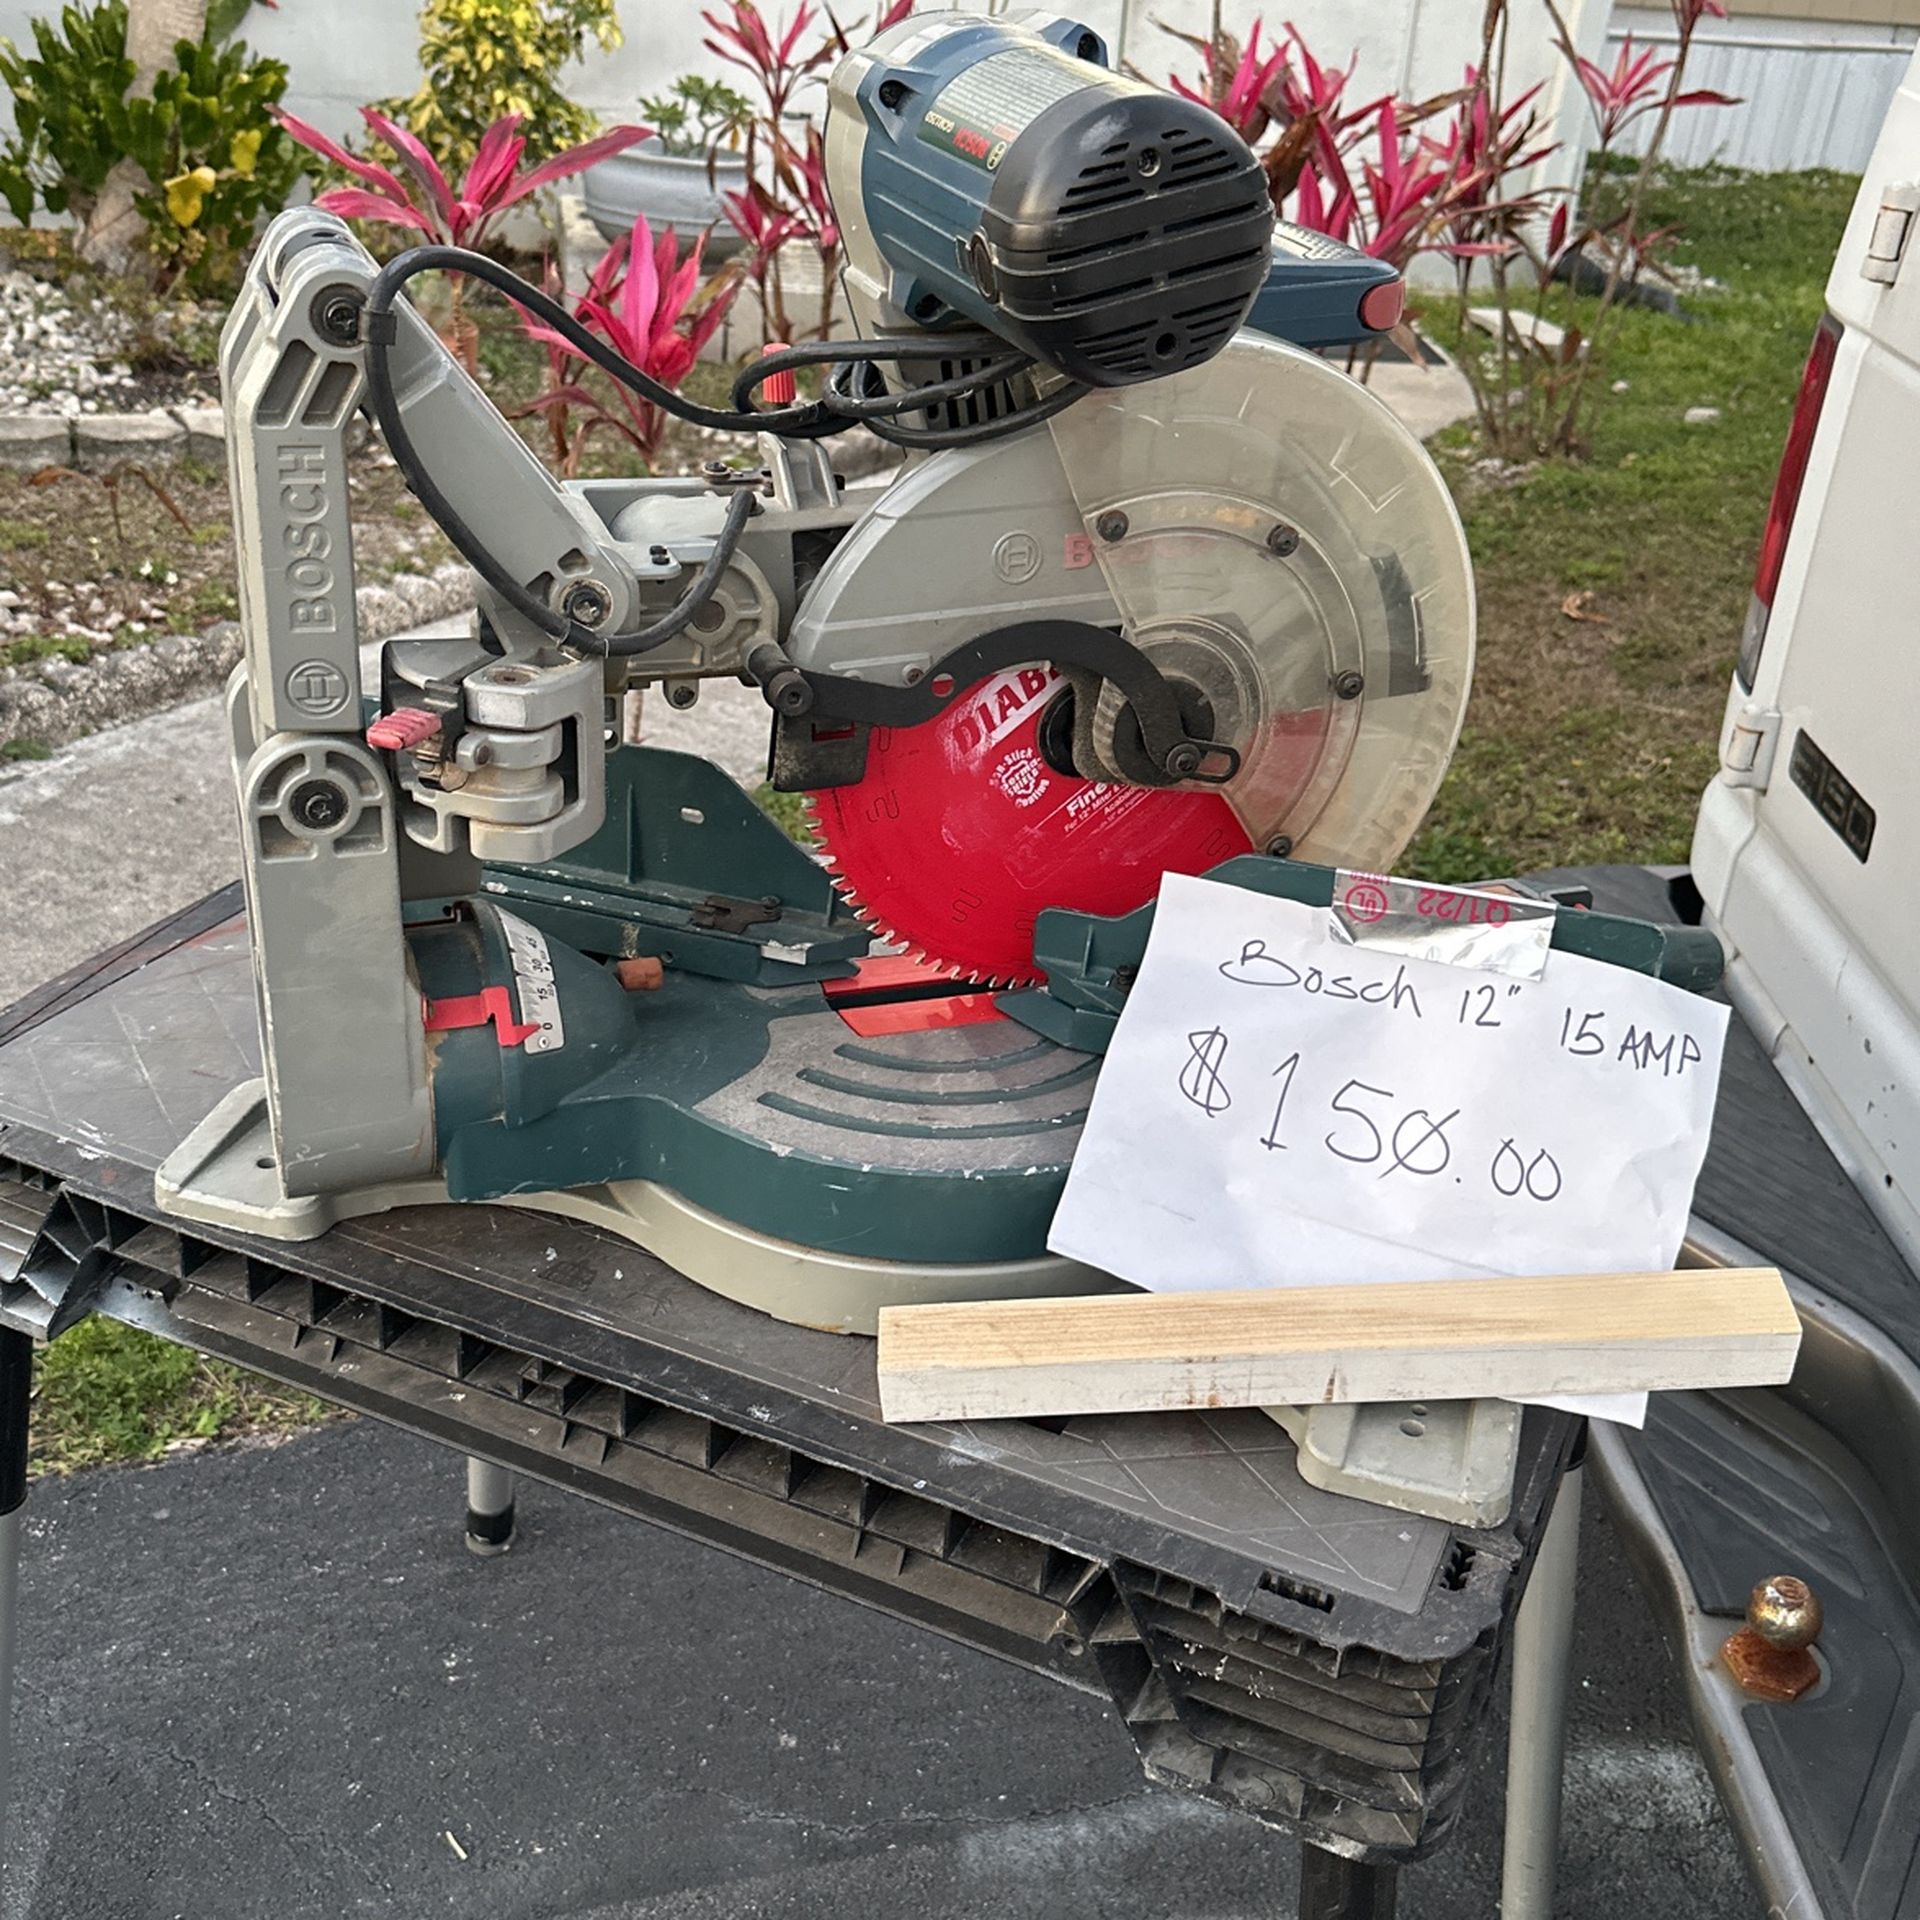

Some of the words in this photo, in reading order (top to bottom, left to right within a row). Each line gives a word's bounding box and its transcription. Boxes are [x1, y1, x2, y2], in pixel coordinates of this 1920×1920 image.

[277, 444, 336, 633] BOSCH
[1065, 781, 1108, 818] Fine
[532, 958, 543, 972] 30
[537, 986, 548, 1000] 15
[1219, 938, 1422, 1019] Bosch
[1456, 984, 1524, 1028] 12"
[1560, 1008, 1604, 1057] 15
[1617, 1026, 1701, 1077] AMP
